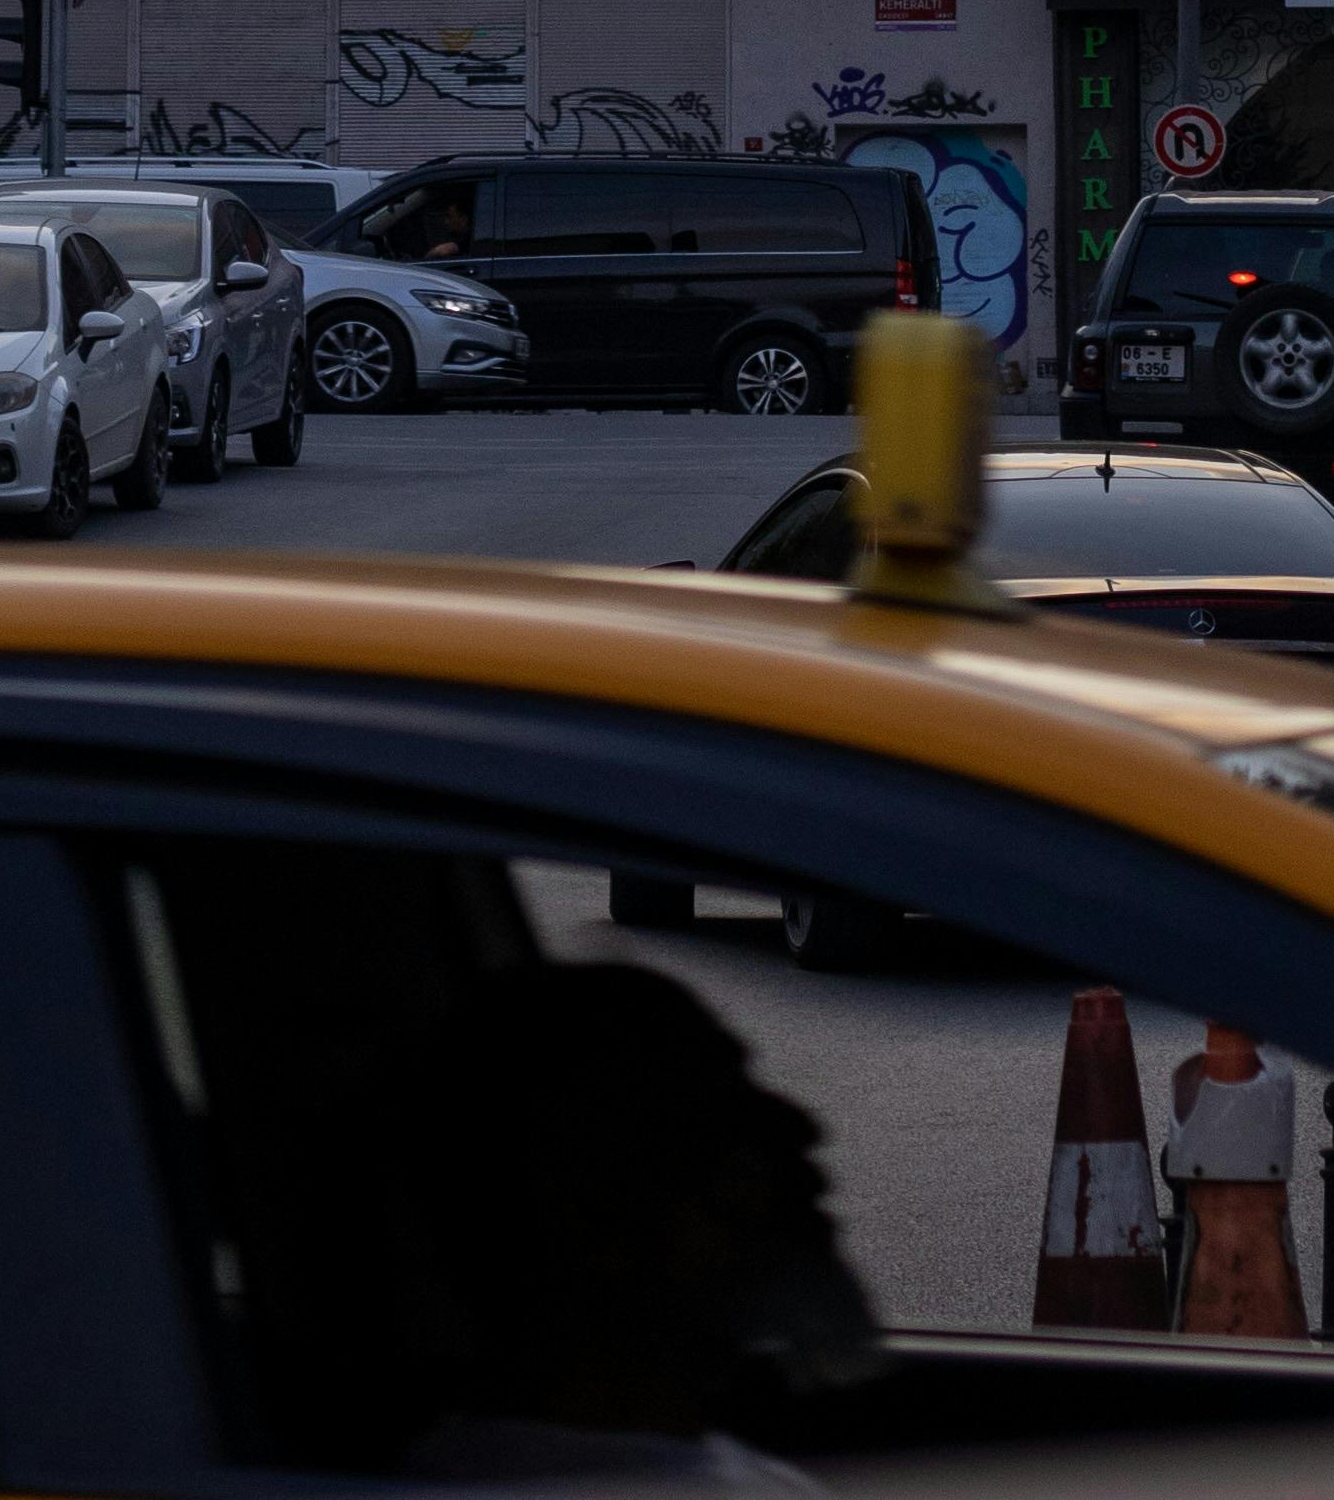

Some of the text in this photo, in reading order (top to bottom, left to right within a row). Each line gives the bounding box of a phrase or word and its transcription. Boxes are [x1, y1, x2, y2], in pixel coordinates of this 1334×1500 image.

[1123, 347, 1141, 360] 06
[1162, 347, 1172, 360] E
[1136, 362, 1170, 376] 6350
